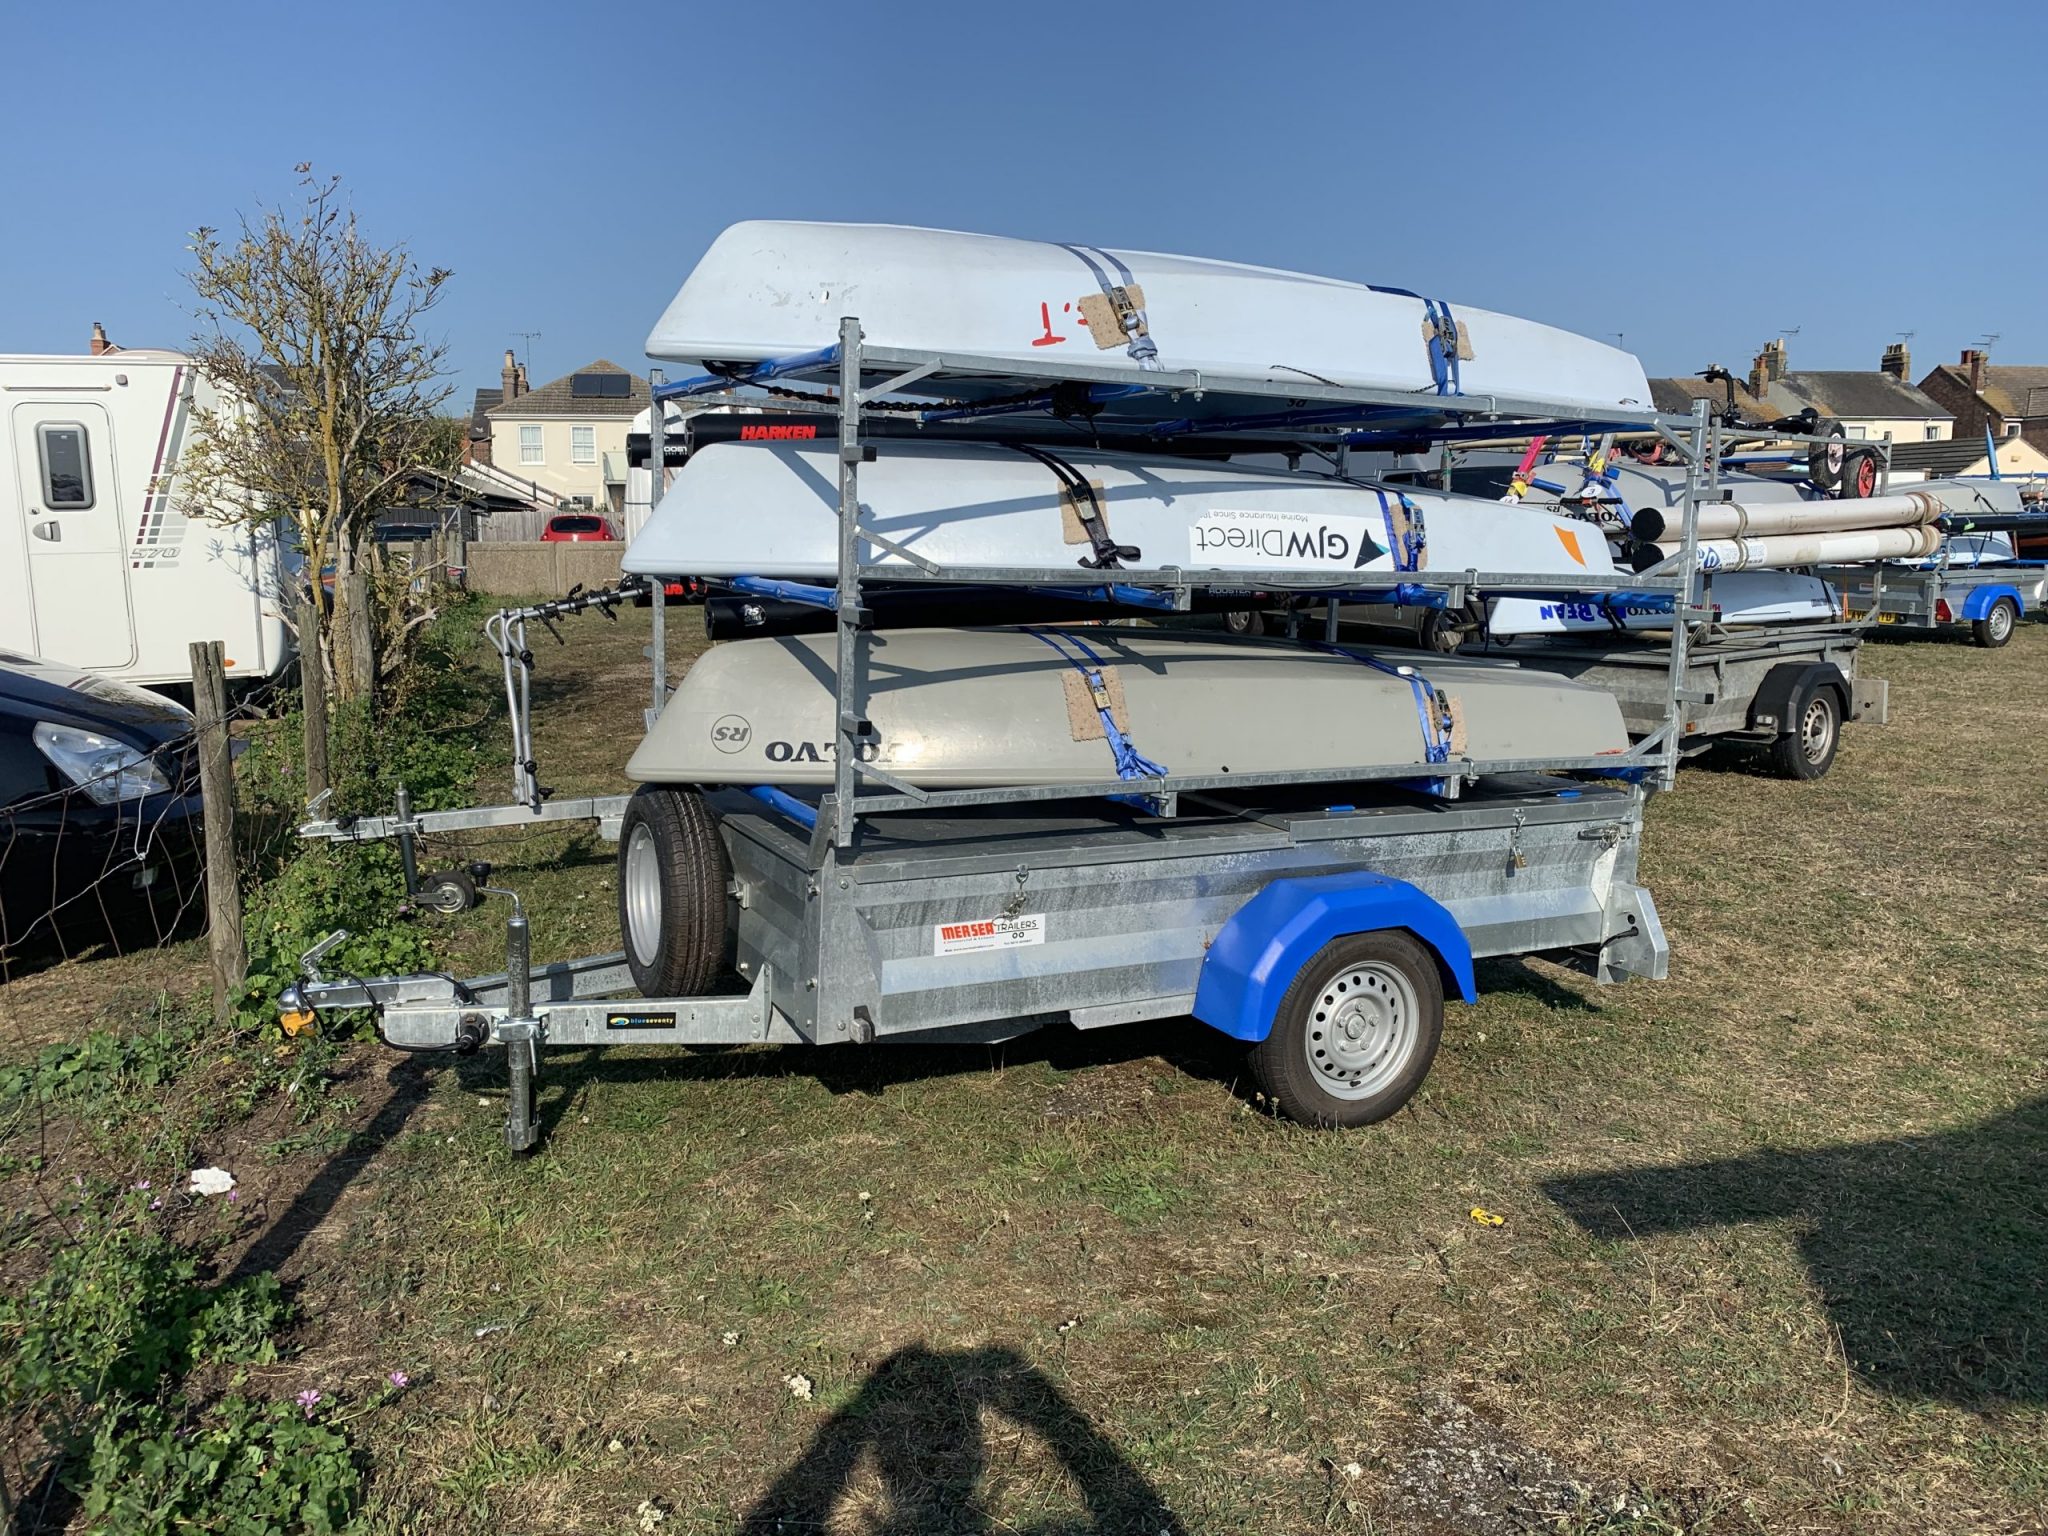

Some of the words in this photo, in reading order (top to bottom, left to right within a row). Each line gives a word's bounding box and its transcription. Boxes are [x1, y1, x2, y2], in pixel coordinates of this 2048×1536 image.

[740, 425, 817, 440] HARKEN
[1213, 510, 1237, 520] Since
[1239, 511, 1280, 521] Insurance
[1281, 514, 1309, 523] Marine
[1195, 526, 1349, 560] GJWDirect
[129, 546, 181, 559] 570
[713, 726, 750, 742] RS
[941, 922, 995, 940] MERSEA
[997, 920, 1037, 932] TRAILERS
